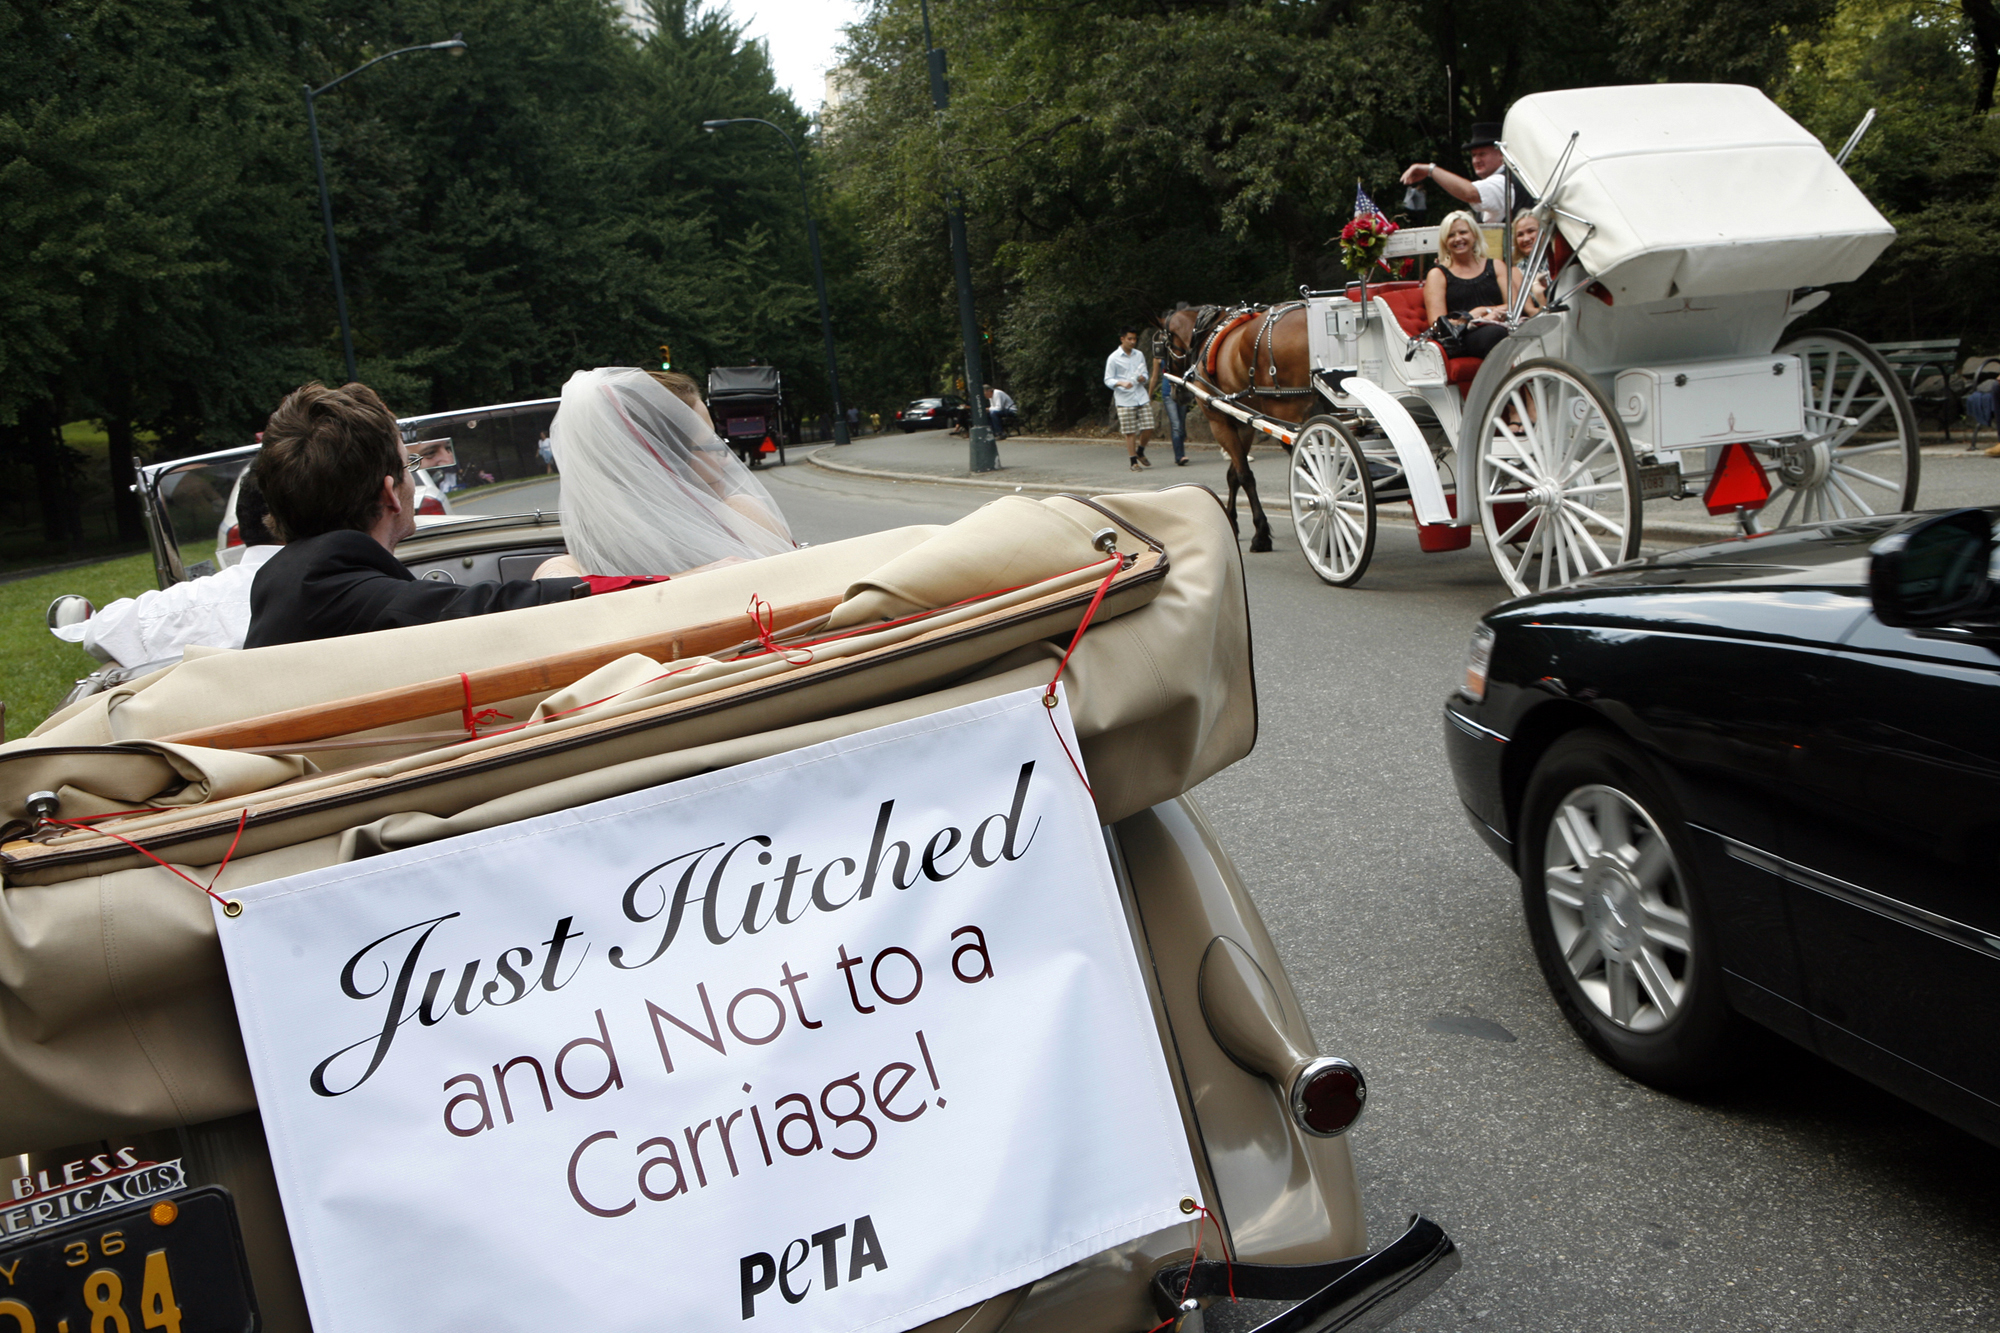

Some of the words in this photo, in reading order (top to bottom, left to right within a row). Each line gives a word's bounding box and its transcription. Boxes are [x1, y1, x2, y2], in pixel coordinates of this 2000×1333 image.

[310, 911, 592, 1098] Just
[608, 760, 1042, 970] Hitched
[442, 1009, 624, 1137] and
[644, 961, 823, 1075] Not
[836, 943, 923, 1014] to
[950, 924, 994, 984] a
[11, 1146, 138, 1200] BLESS
[566, 1030, 947, 1219] Carriage!
[0, 1183, 125, 1237] ERICA
[63, 1231, 126, 1267] 36
